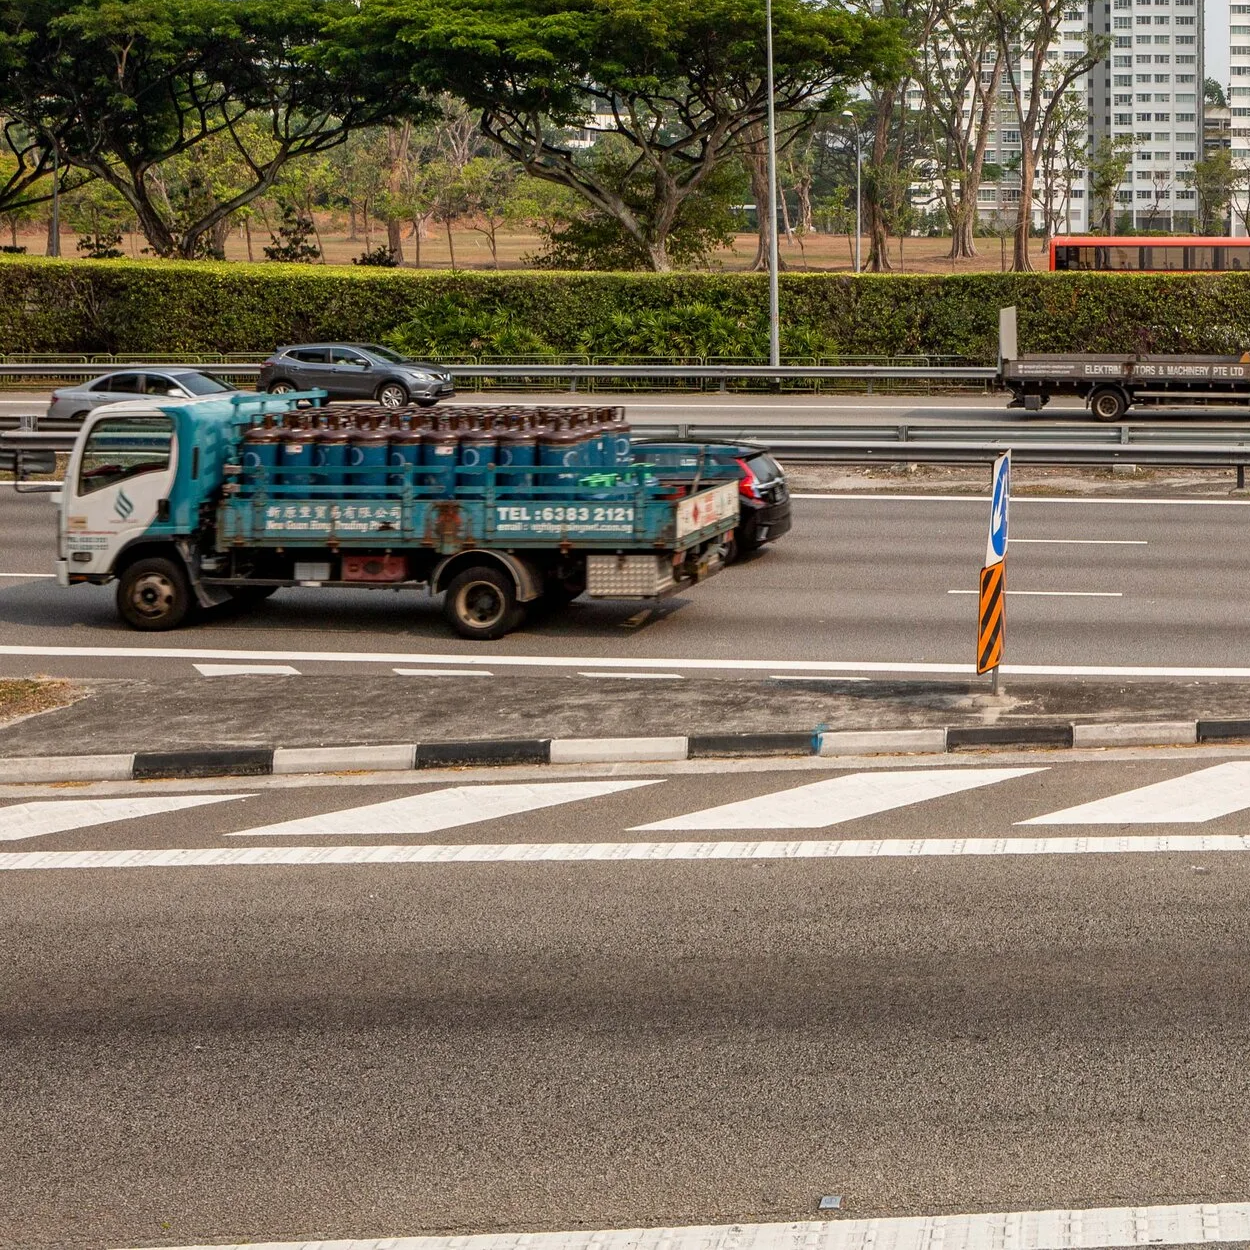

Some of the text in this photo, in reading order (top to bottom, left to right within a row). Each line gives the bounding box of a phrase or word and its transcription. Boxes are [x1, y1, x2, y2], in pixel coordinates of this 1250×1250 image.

[1084, 364, 1121, 375] ELEKTRIM
[1158, 366, 1164, 375] &
[1167, 365, 1209, 376] MACHINERY
[1212, 366, 1228, 376] PTE
[1230, 366, 1244, 376] LTD
[497, 507, 531, 521] TEL
[593, 508, 634, 521] 2121
